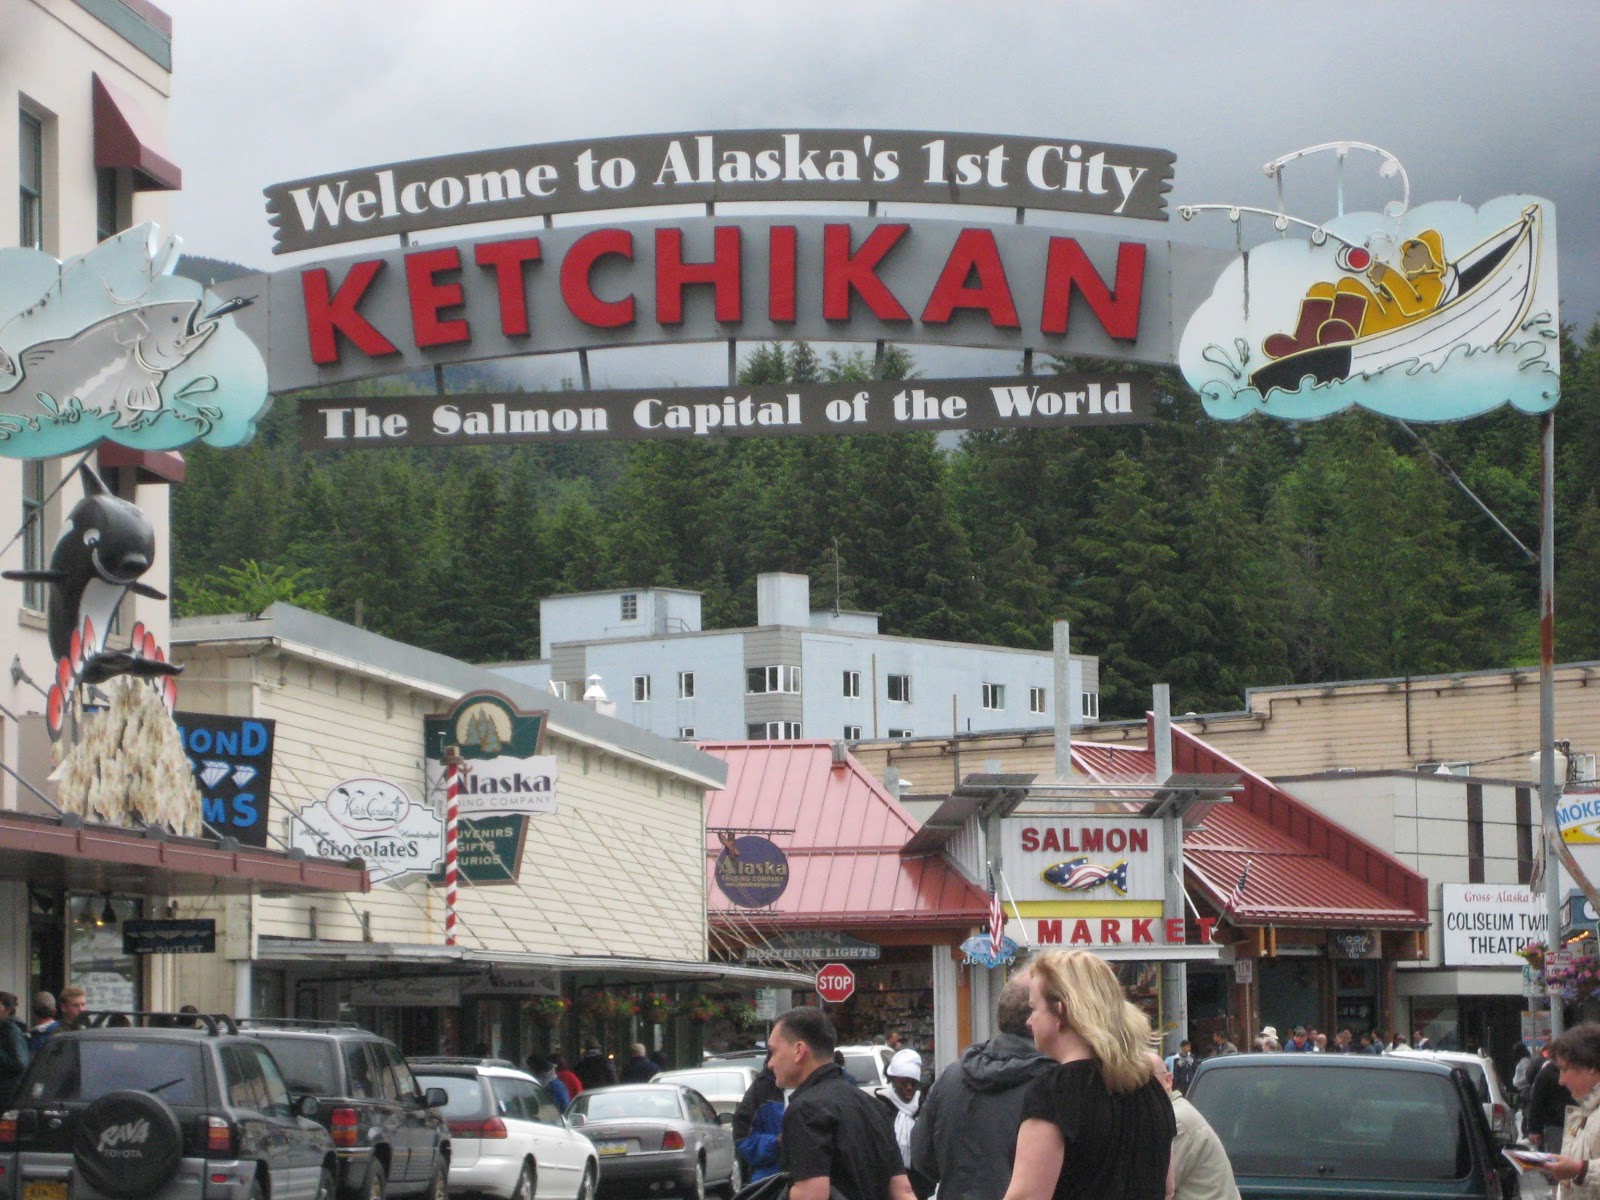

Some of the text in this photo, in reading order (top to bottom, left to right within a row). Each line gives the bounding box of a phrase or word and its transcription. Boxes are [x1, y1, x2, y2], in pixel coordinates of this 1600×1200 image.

[289, 133, 1148, 232] Welcome to Alaska's 1st City
[300, 222, 1147, 367] KETCHIKAN
[318, 380, 1134, 441] The Salmon Capital of the World
[432, 770, 551, 796] Alaska
[431, 796, 551, 808] TRING COMPANY
[457, 841, 495, 852] GIFTS
[1021, 827, 1149, 852] SALMON
[457, 854, 500, 866] URIOS
[719, 855, 788, 875] Alaska
[1037, 917, 1217, 944] MARKET
[1447, 912, 1514, 931] COLISEUM
[746, 947, 877, 958] NORTHERN LIGHTS
[819, 976, 851, 990] STOP
[103, 1149, 142, 1158] TOYOTA
